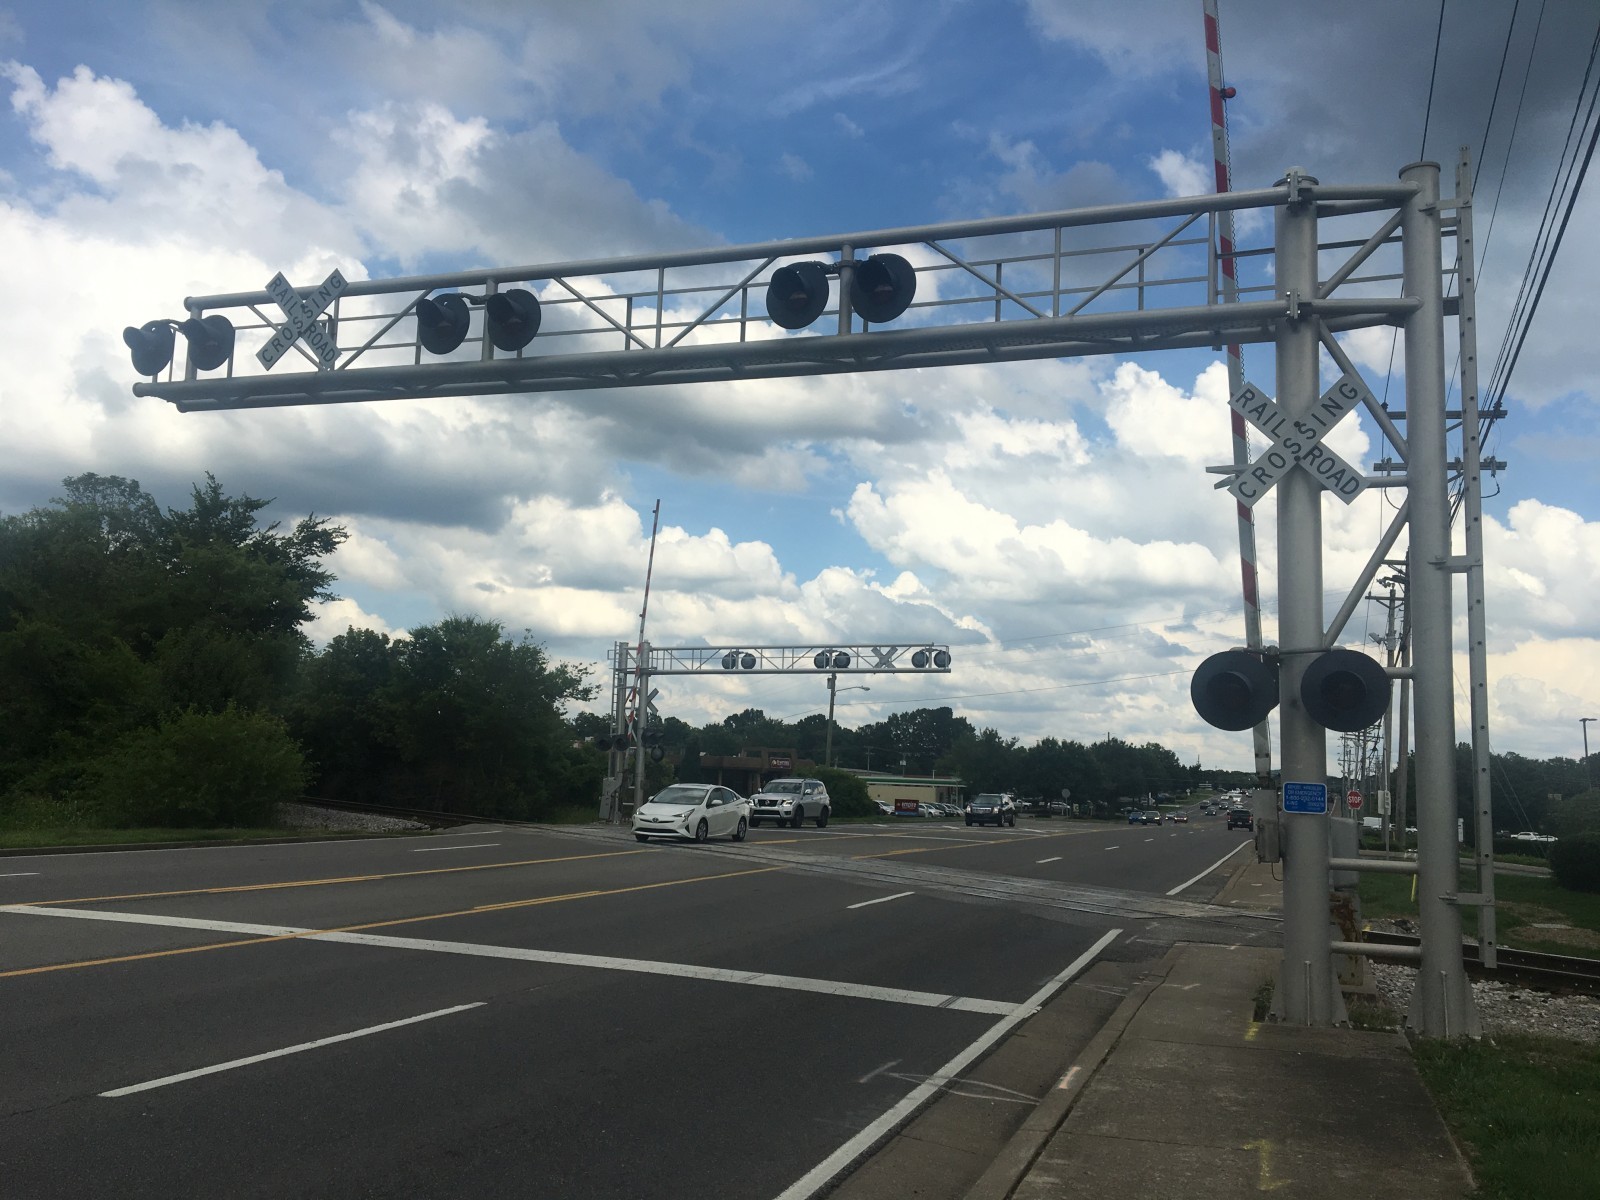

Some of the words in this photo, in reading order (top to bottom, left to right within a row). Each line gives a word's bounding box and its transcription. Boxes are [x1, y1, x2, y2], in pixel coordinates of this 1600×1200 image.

[262, 276, 342, 363] CROSSING
[269, 277, 297, 316] RAIL
[307, 322, 335, 362] ROAD
[1235, 388, 1286, 438] RAIL
[1302, 445, 1360, 495] ROAD
[1238, 383, 1358, 499] CROSSING
